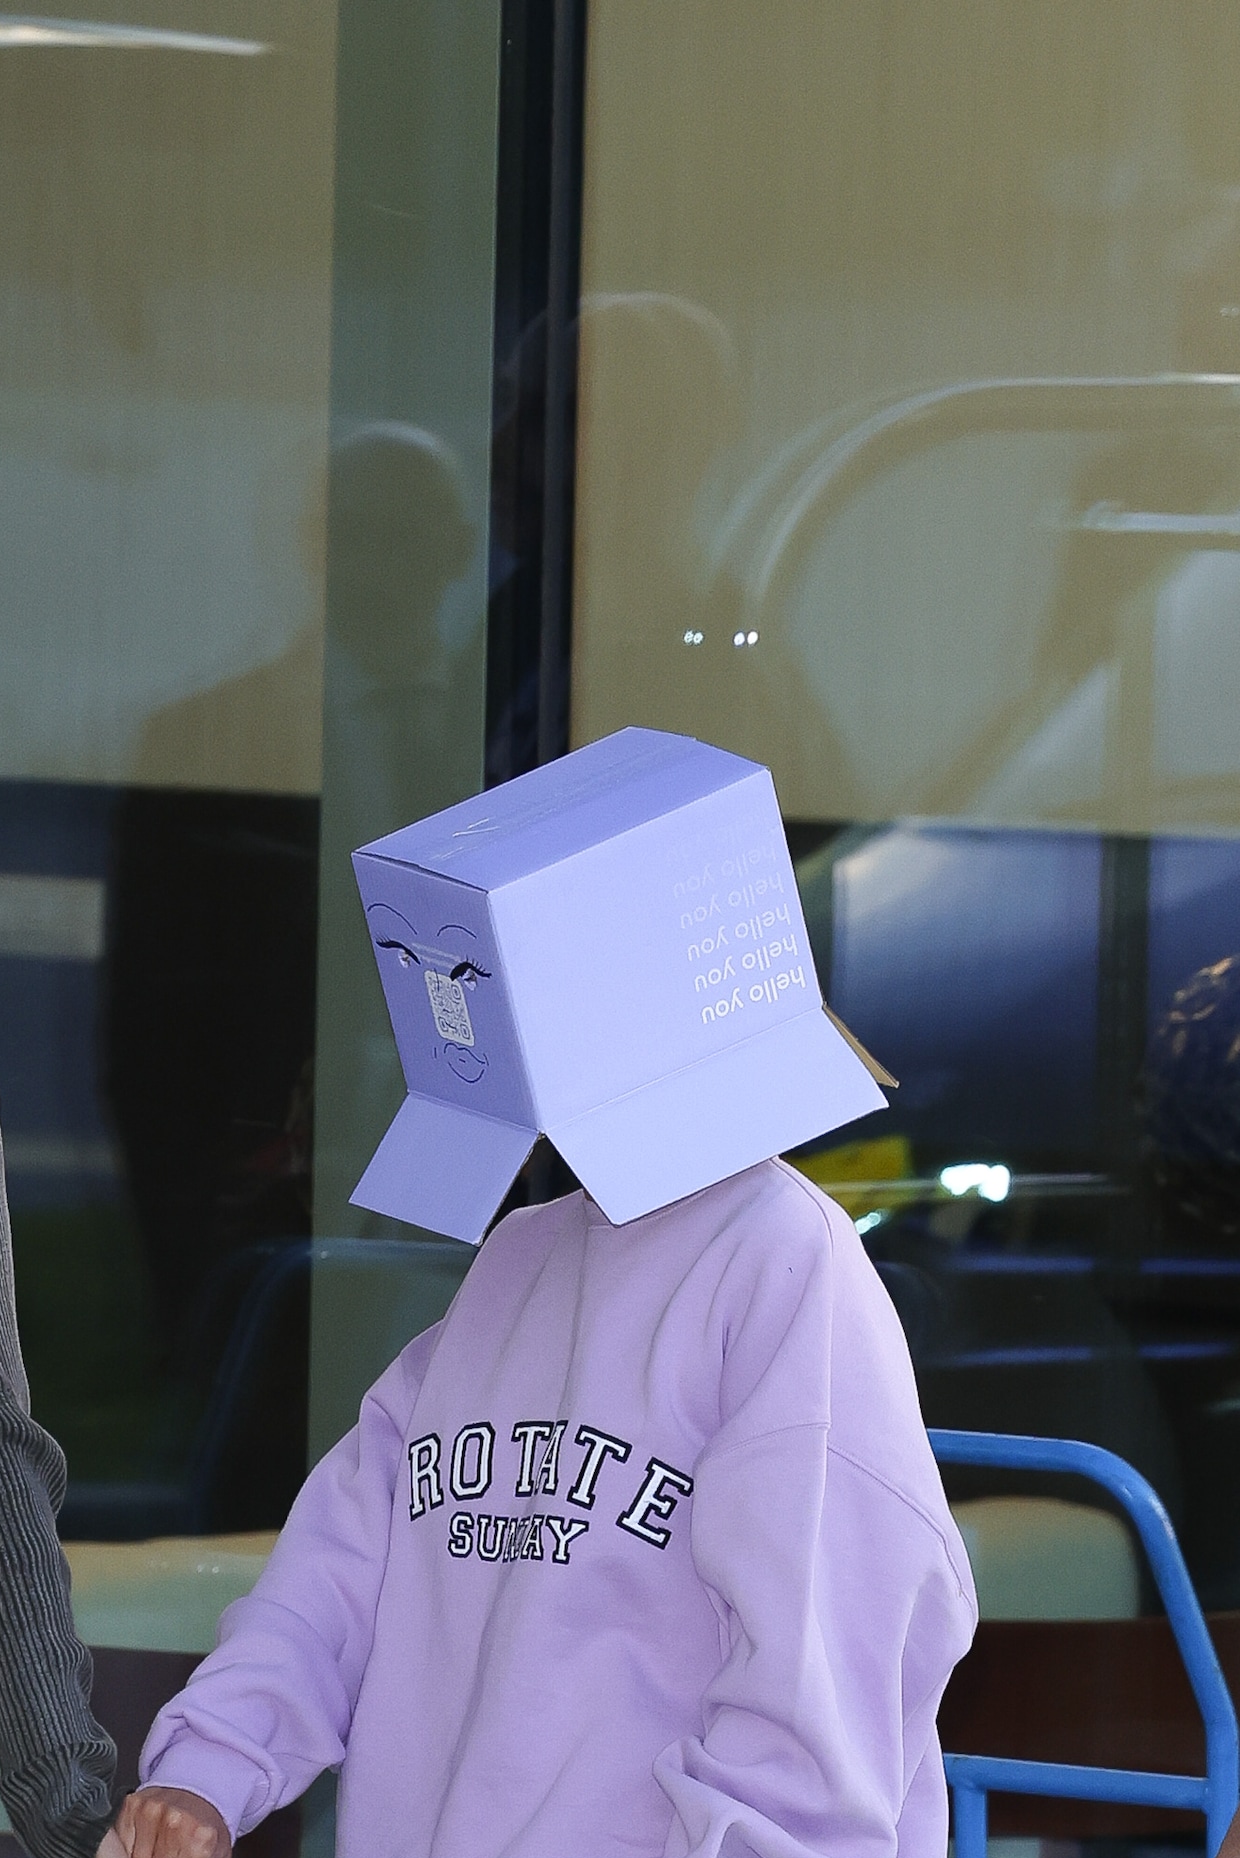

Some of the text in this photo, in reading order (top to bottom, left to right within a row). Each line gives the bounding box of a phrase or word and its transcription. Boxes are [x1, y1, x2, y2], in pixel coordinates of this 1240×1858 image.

[680, 872, 784, 929] hello you
[687, 903, 791, 961] hello you
[694, 933, 798, 992] hello you
[701, 966, 807, 1024] hello you
[409, 1420, 695, 1550] ROTATE
[448, 1512, 589, 1565] SUAY
